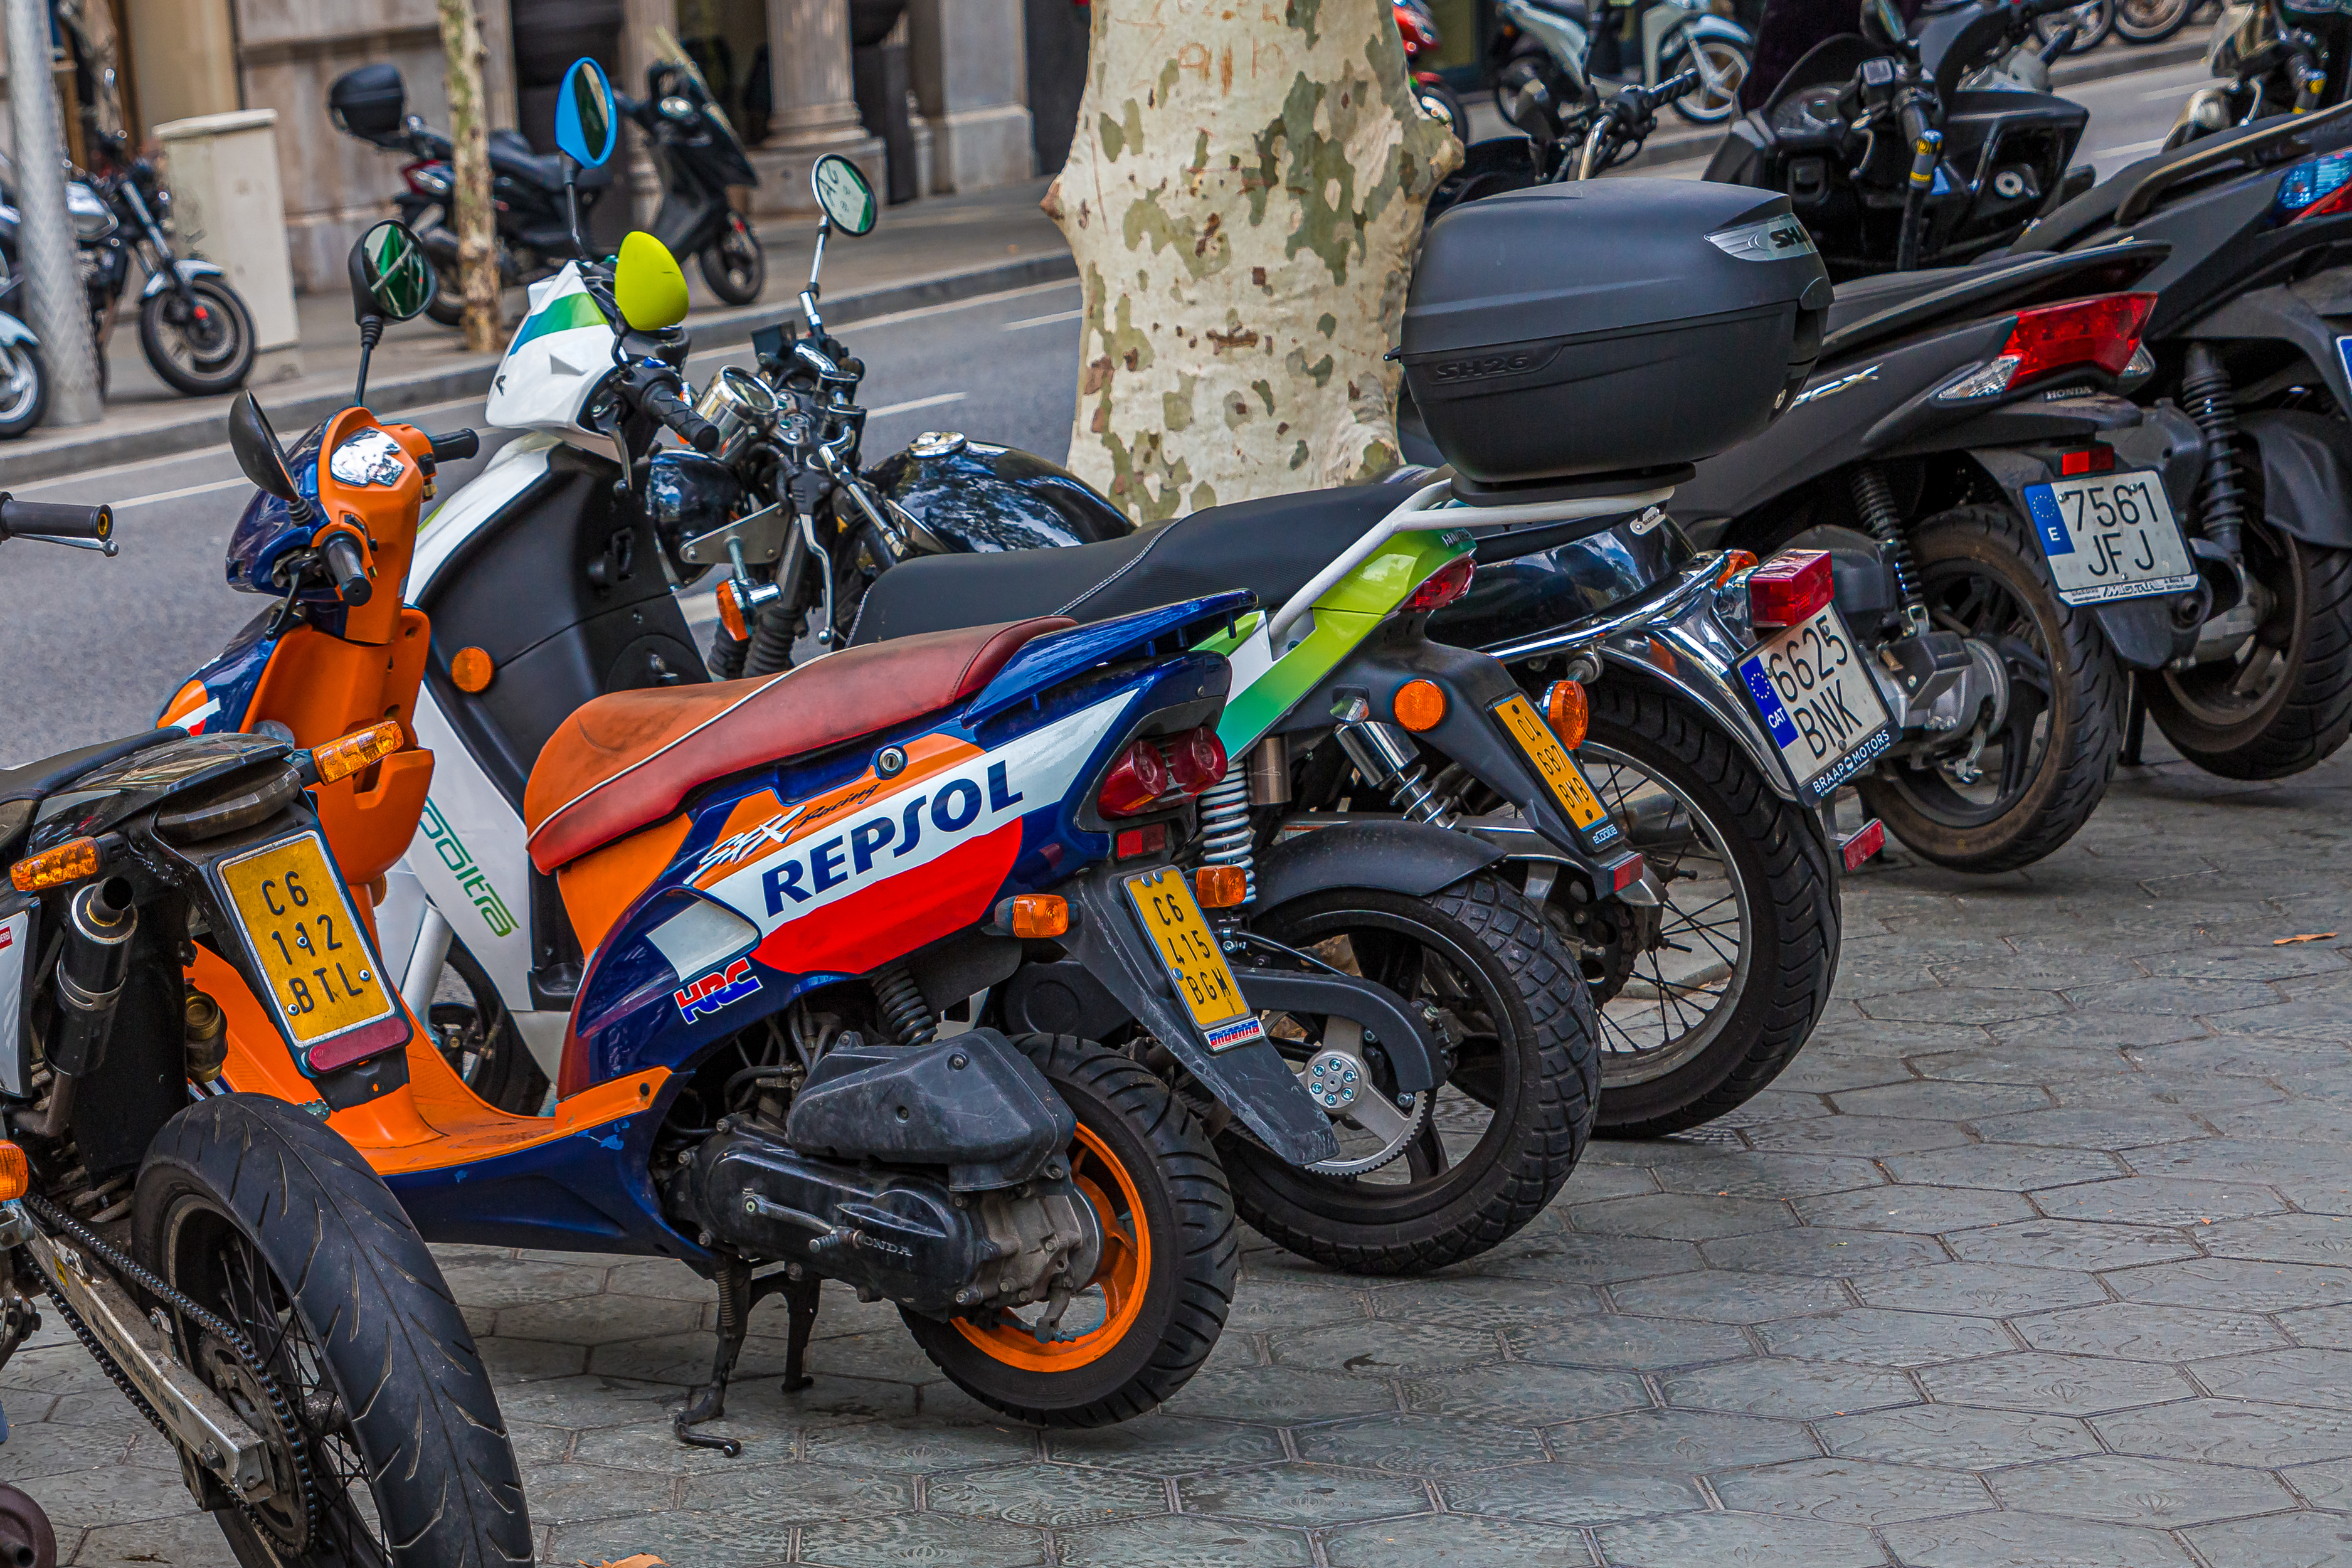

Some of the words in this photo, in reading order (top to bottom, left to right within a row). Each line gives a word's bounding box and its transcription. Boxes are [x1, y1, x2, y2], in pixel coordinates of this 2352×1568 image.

[1436, 354, 1529, 381] SH26
[2046, 386, 2093, 400] HONDA
[2063, 481, 2158, 531] 7561
[2047, 527, 2061, 541] E
[2087, 529, 2155, 576] JFJ
[1769, 614, 1848, 704] 6625
[1517, 716, 1543, 742] C4
[1767, 707, 1786, 729] CAT
[1793, 679, 1863, 761] BNK
[1536, 744, 1566, 776] 687
[1812, 763, 1844, 793] BRAAP
[1851, 729, 1890, 764] MOTORS
[797, 782, 882, 830] Racing
[761, 759, 1024, 919] REPSOL
[261, 870, 309, 916] C6
[1153, 893, 1185, 926] C6
[272, 914, 342, 965] 112
[1167, 930, 1211, 966] 415
[289, 961, 364, 1014] BTL
[674, 956, 764, 1025] HRC
[1185, 967, 1232, 1005] BGM
